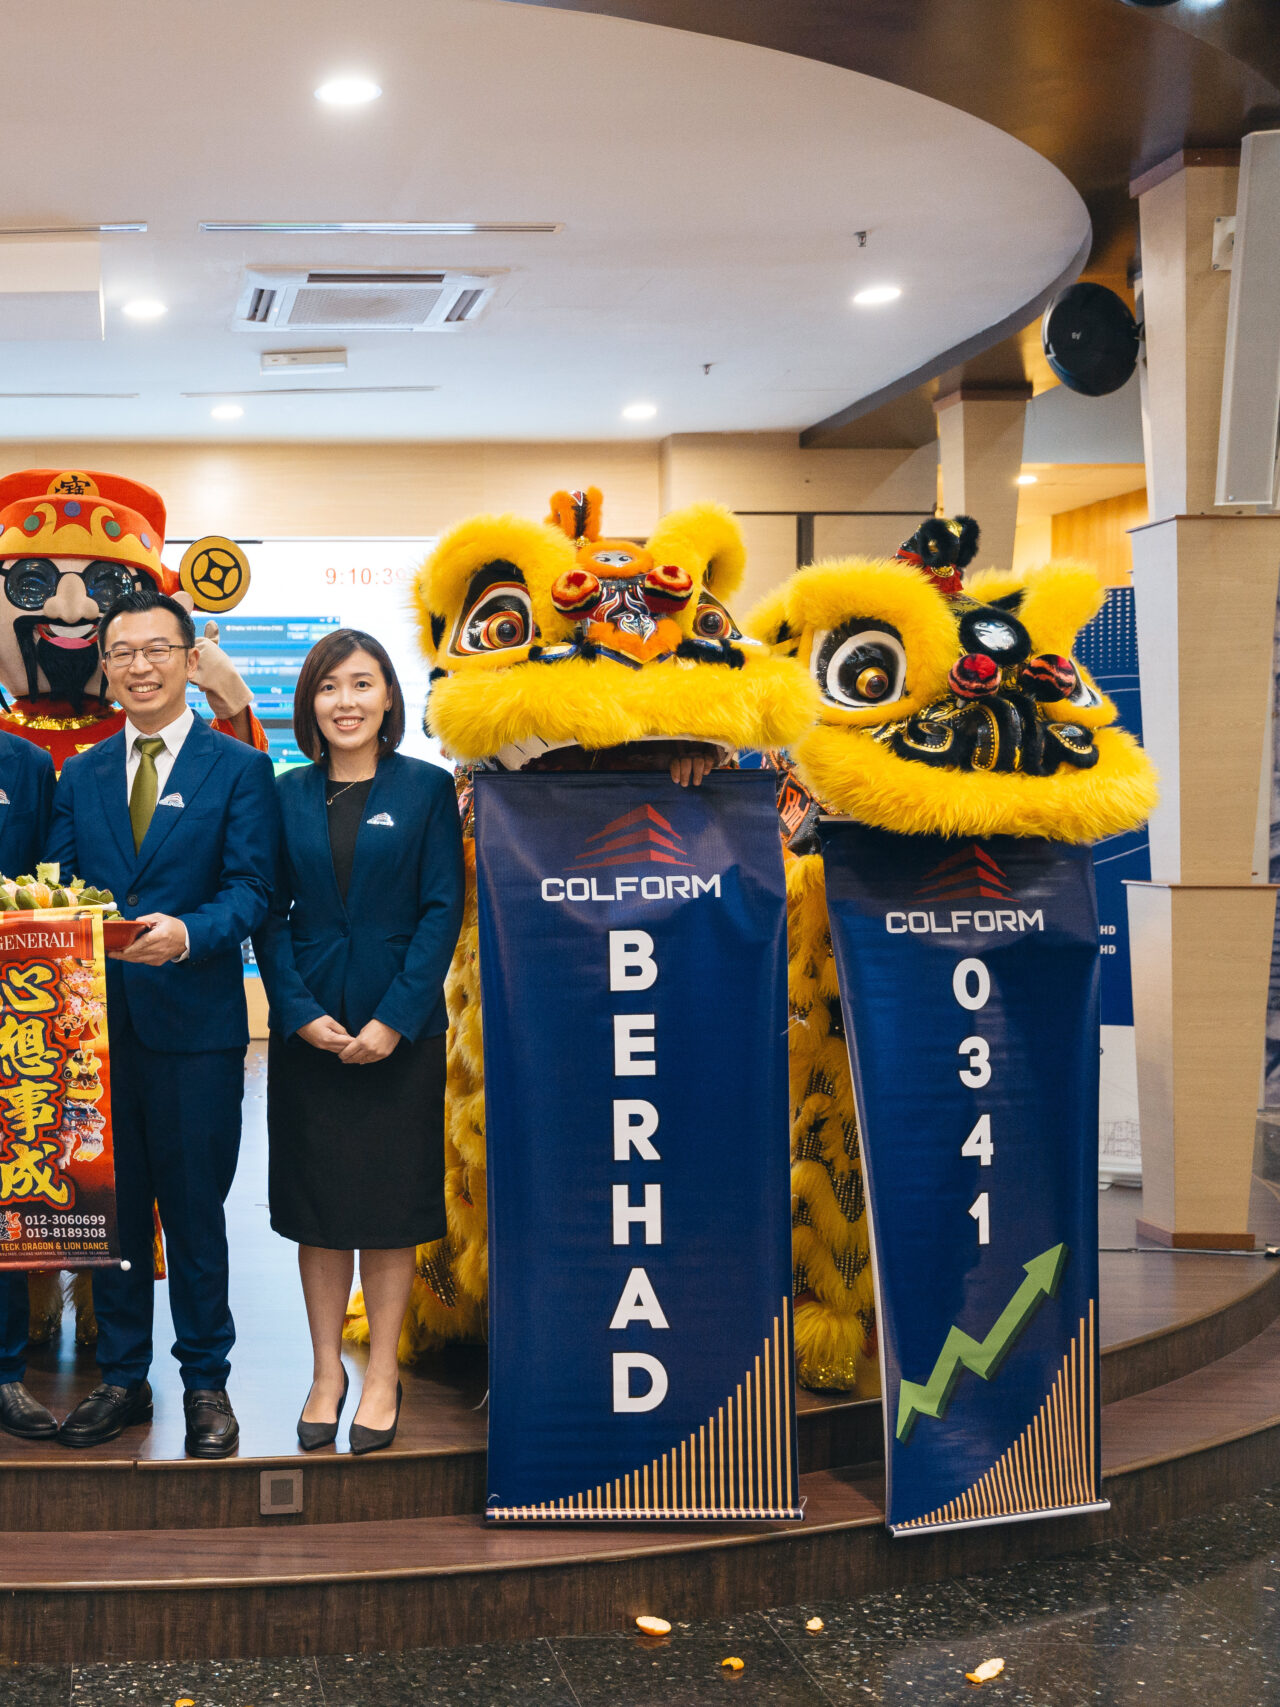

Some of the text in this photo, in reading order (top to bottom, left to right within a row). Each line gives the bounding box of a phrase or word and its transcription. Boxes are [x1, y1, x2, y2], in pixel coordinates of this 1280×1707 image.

[541, 874, 721, 902] COLFORM
[885, 909, 1045, 934] COLFORM
[952, 957, 995, 1246] 0341
[608, 929, 669, 1413] BERHAD
[24, 1214, 106, 1226] 012-3060699
[26, 1227, 107, 1239] 019-8189308
[1, 1242, 20, 1251] TECK
[22, 1242, 54, 1251] DRAGON
[55, 1242, 62, 1250] &
[63, 1241, 81, 1250] LION
[82, 1241, 109, 1250] DANCE
